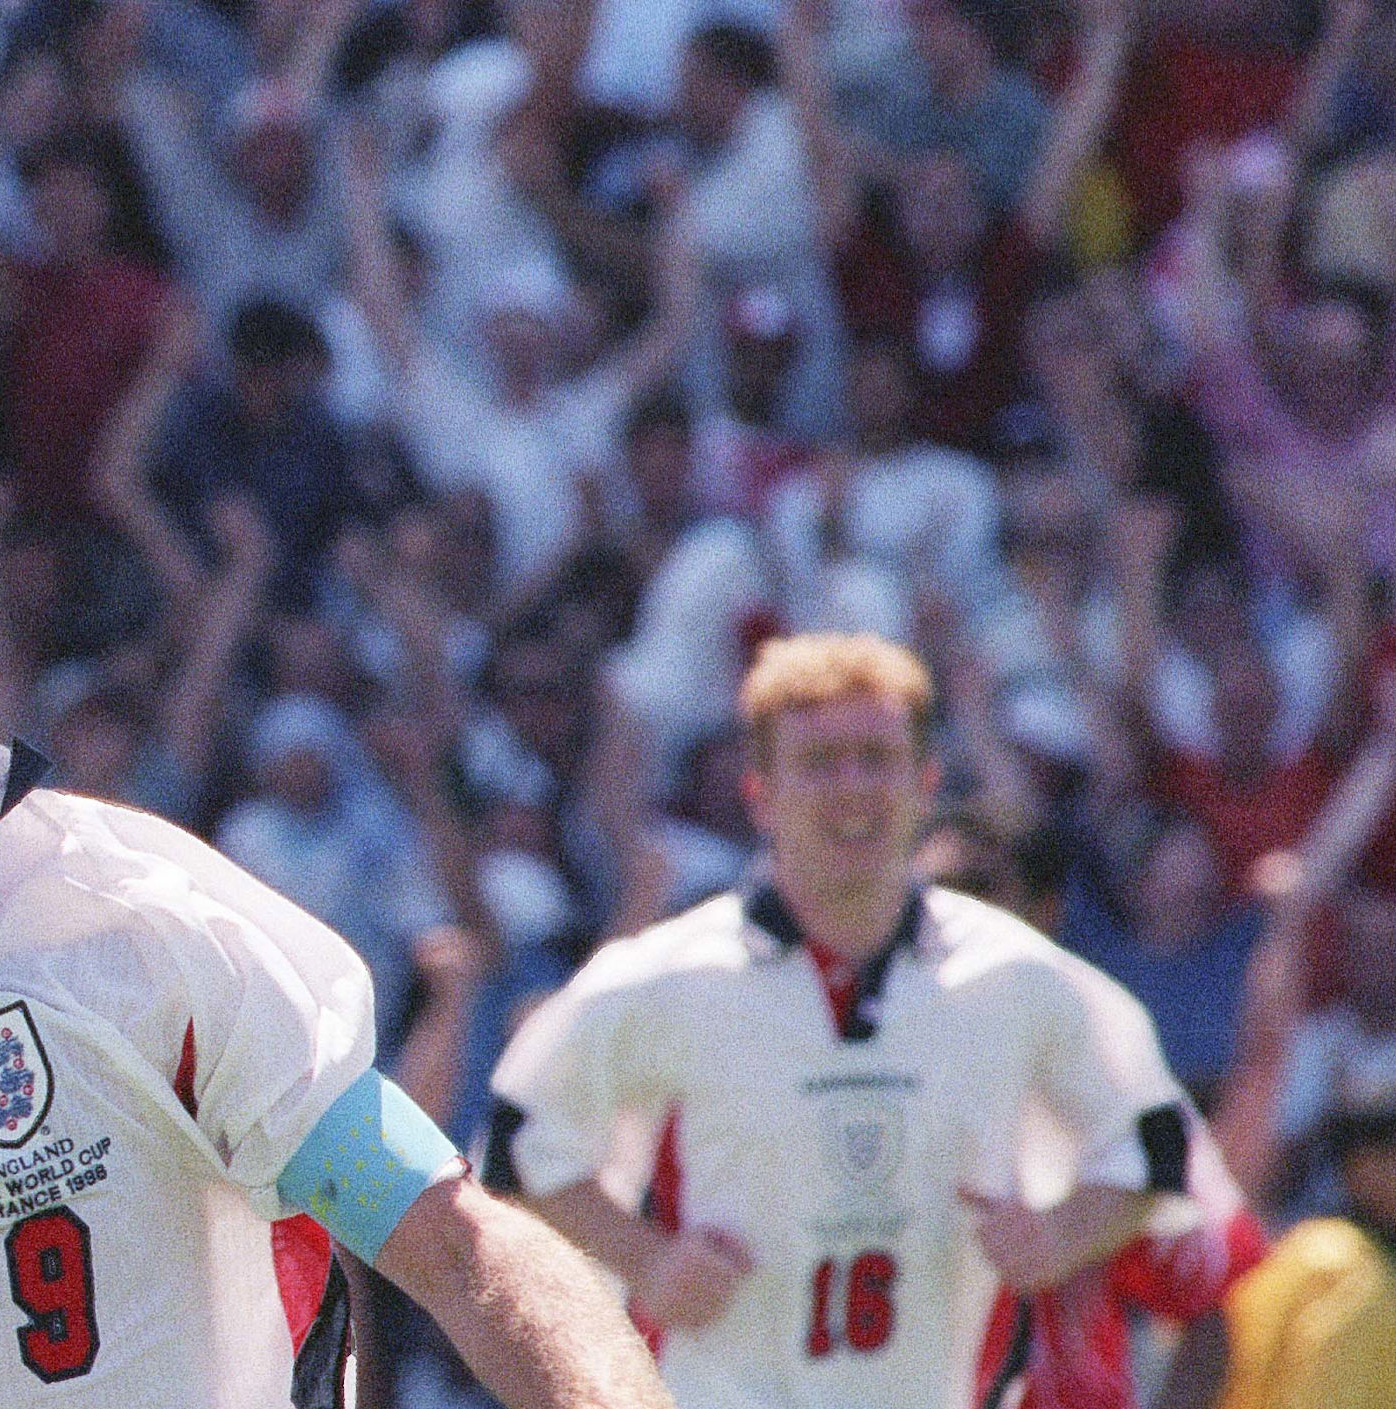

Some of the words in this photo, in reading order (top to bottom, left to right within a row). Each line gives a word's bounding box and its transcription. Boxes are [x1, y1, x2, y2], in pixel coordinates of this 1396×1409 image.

[5, 1160, 73, 1198] WORLD
[79, 1136, 112, 1166] CUP
[65, 1164, 108, 1196] 1998
[4, 1204, 100, 1384] 9
[805, 1250, 899, 1360] 16
